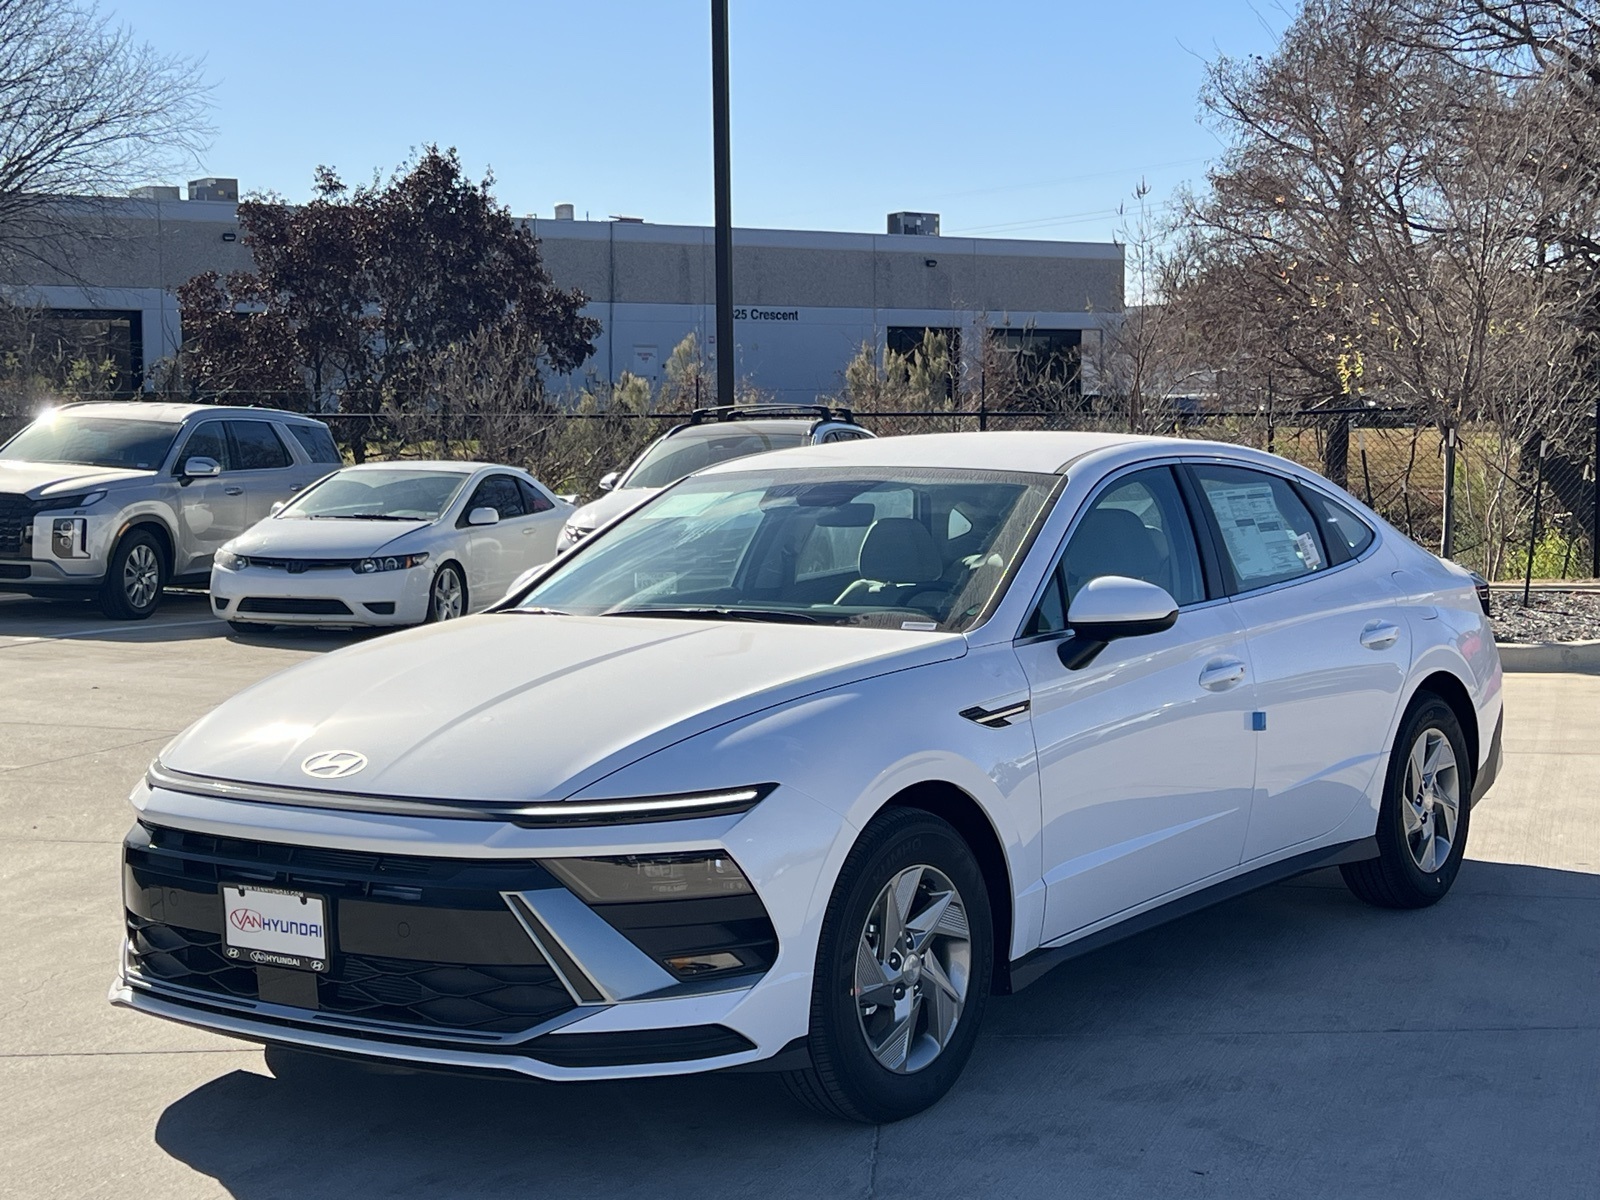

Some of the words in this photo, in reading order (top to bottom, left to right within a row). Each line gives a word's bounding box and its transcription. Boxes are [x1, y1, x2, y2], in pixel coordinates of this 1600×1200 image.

[732, 309, 747, 320] 25
[750, 309, 799, 321] Crescent
[262, 917, 322, 938] HYUNDAI
